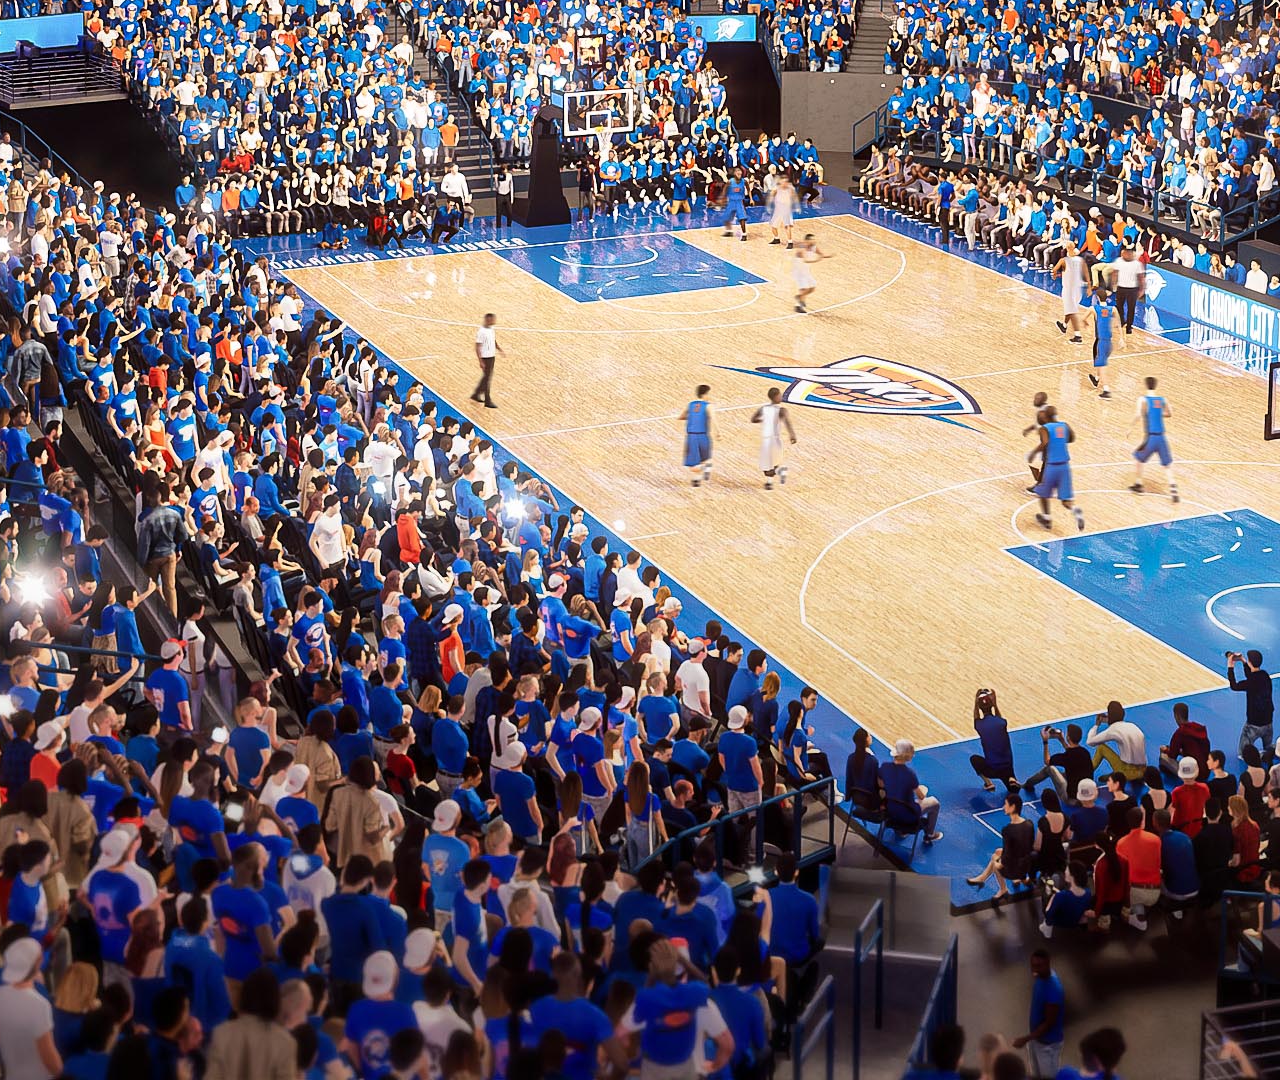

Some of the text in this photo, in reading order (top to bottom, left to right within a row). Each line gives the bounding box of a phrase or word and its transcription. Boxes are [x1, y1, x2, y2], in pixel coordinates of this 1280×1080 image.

[269, 236, 530, 271] OKLAHOMA CITY THUNDER
[1190, 282, 1248, 339] OKLAHOMA
[1250, 302, 1276, 348] CITY
